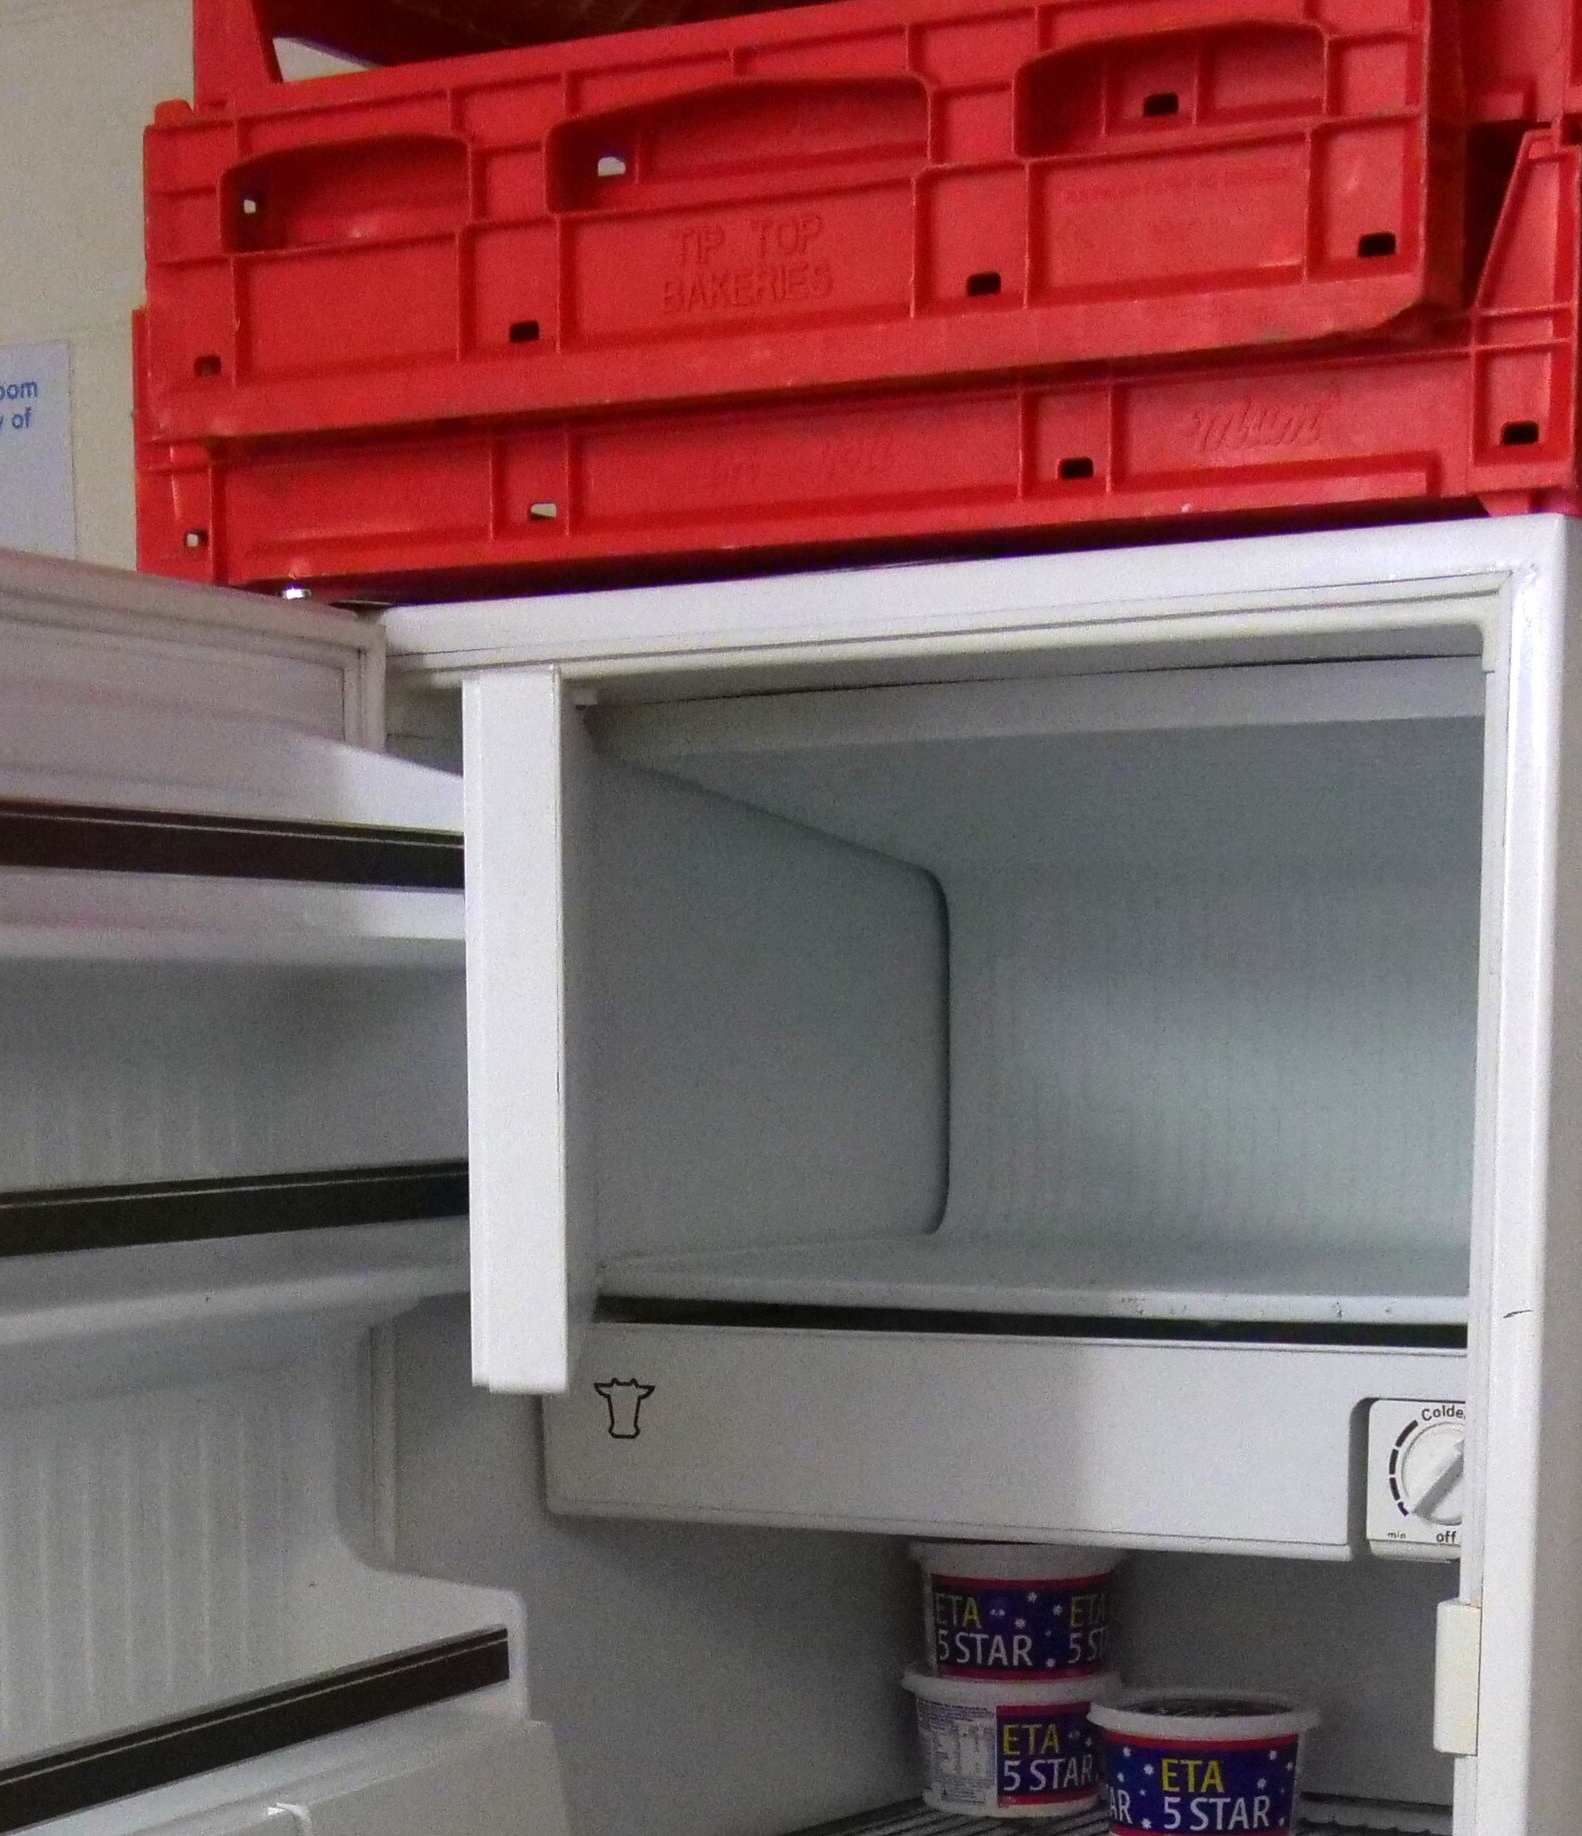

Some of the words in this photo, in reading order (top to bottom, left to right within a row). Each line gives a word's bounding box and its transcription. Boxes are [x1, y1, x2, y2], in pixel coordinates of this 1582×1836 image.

[670, 225, 725, 267] TIP
[751, 212, 824, 258] TOP
[663, 258, 834, 315] BAKERIES
[12, 407, 32, 428] of
[1436, 1531, 1457, 1543] off
[935, 1593, 982, 1628] ETA
[939, 1629, 949, 1660] 5
[955, 1633, 1033, 1666] STAR
[1067, 1632, 1082, 1664] 5
[1002, 1722, 1060, 1756] ETA
[1003, 1760, 1021, 1791] 5
[1030, 1754, 1094, 1791] STAR
[1161, 1759, 1226, 1792] ETA
[1163, 1797, 1182, 1830] 5
[1189, 1795, 1270, 1832] STAR
